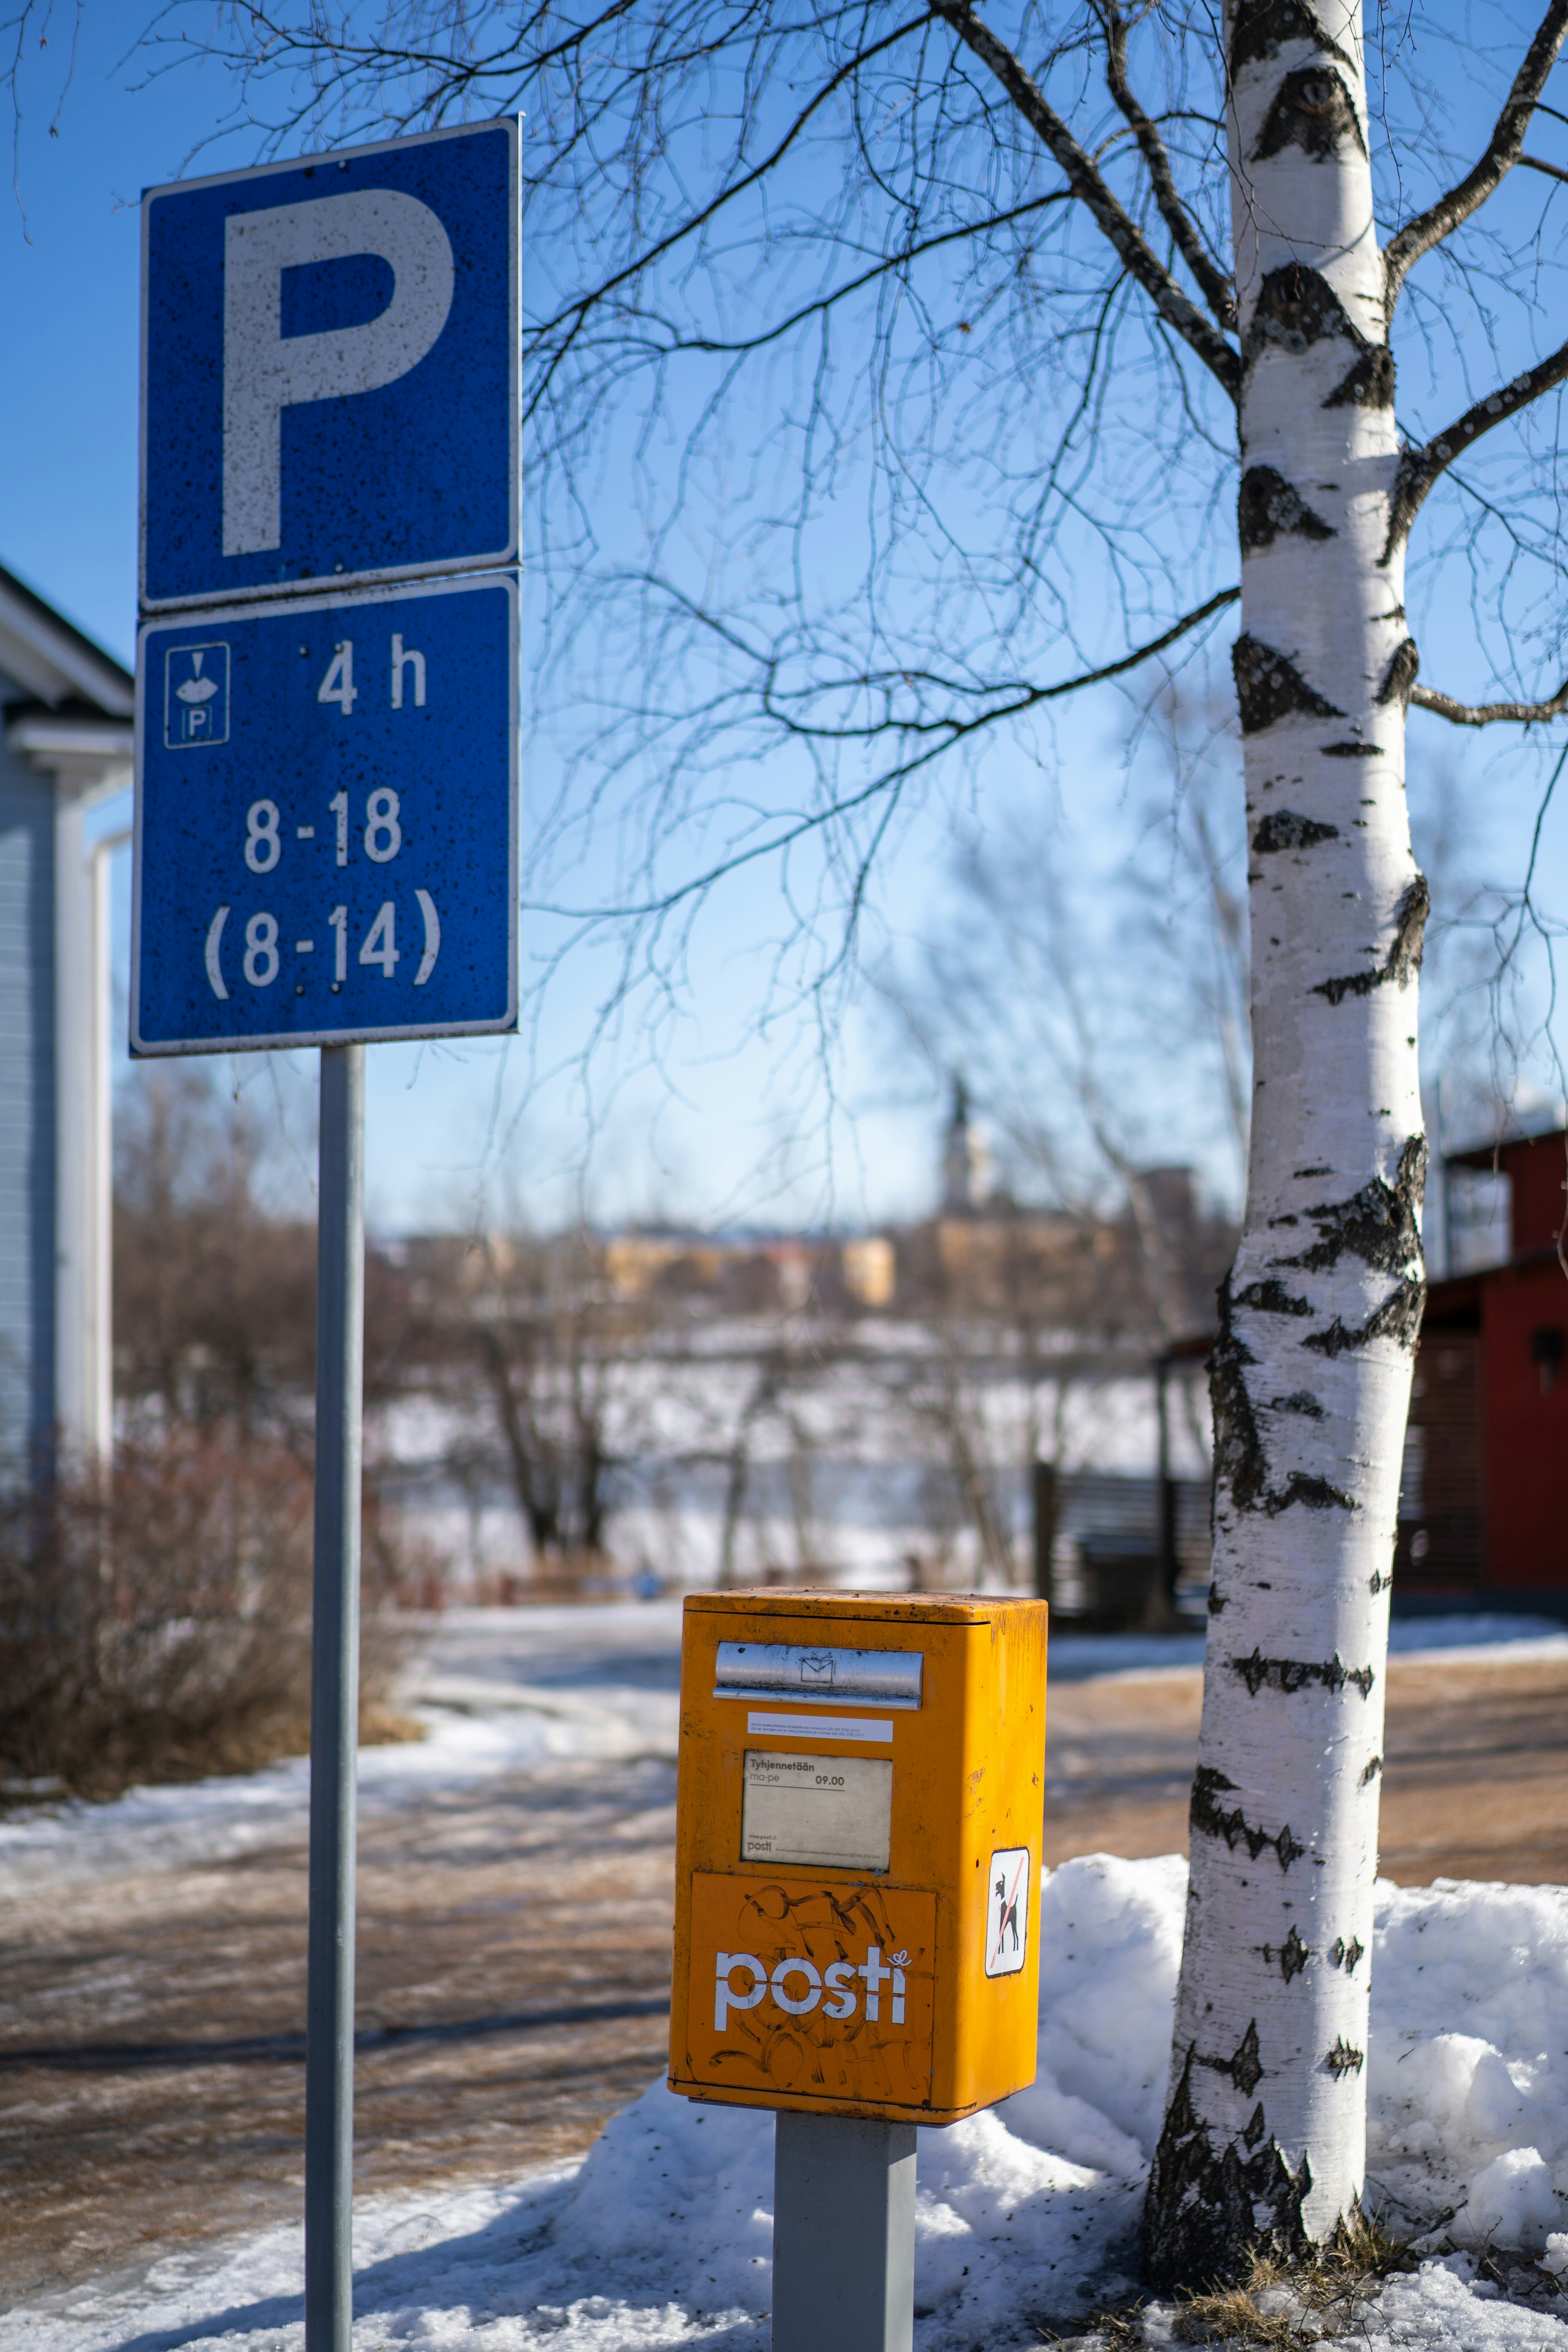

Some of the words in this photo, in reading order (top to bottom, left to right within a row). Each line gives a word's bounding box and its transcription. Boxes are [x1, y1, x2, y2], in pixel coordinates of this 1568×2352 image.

[222, 189, 455, 557] P
[318, 640, 357, 715] 4
[392, 633, 426, 710] h
[189, 710, 206, 737] P
[244, 787, 402, 875] 8-18
[205, 889, 441, 1000] (8-14)
[750, 1759, 814, 1771] Tyhjennetään
[750, 1773, 780, 1783] ma-pe
[816, 1775, 844, 1786] 09.00
[748, 1841, 772, 1852] posti
[714, 1946, 906, 2031] posti
